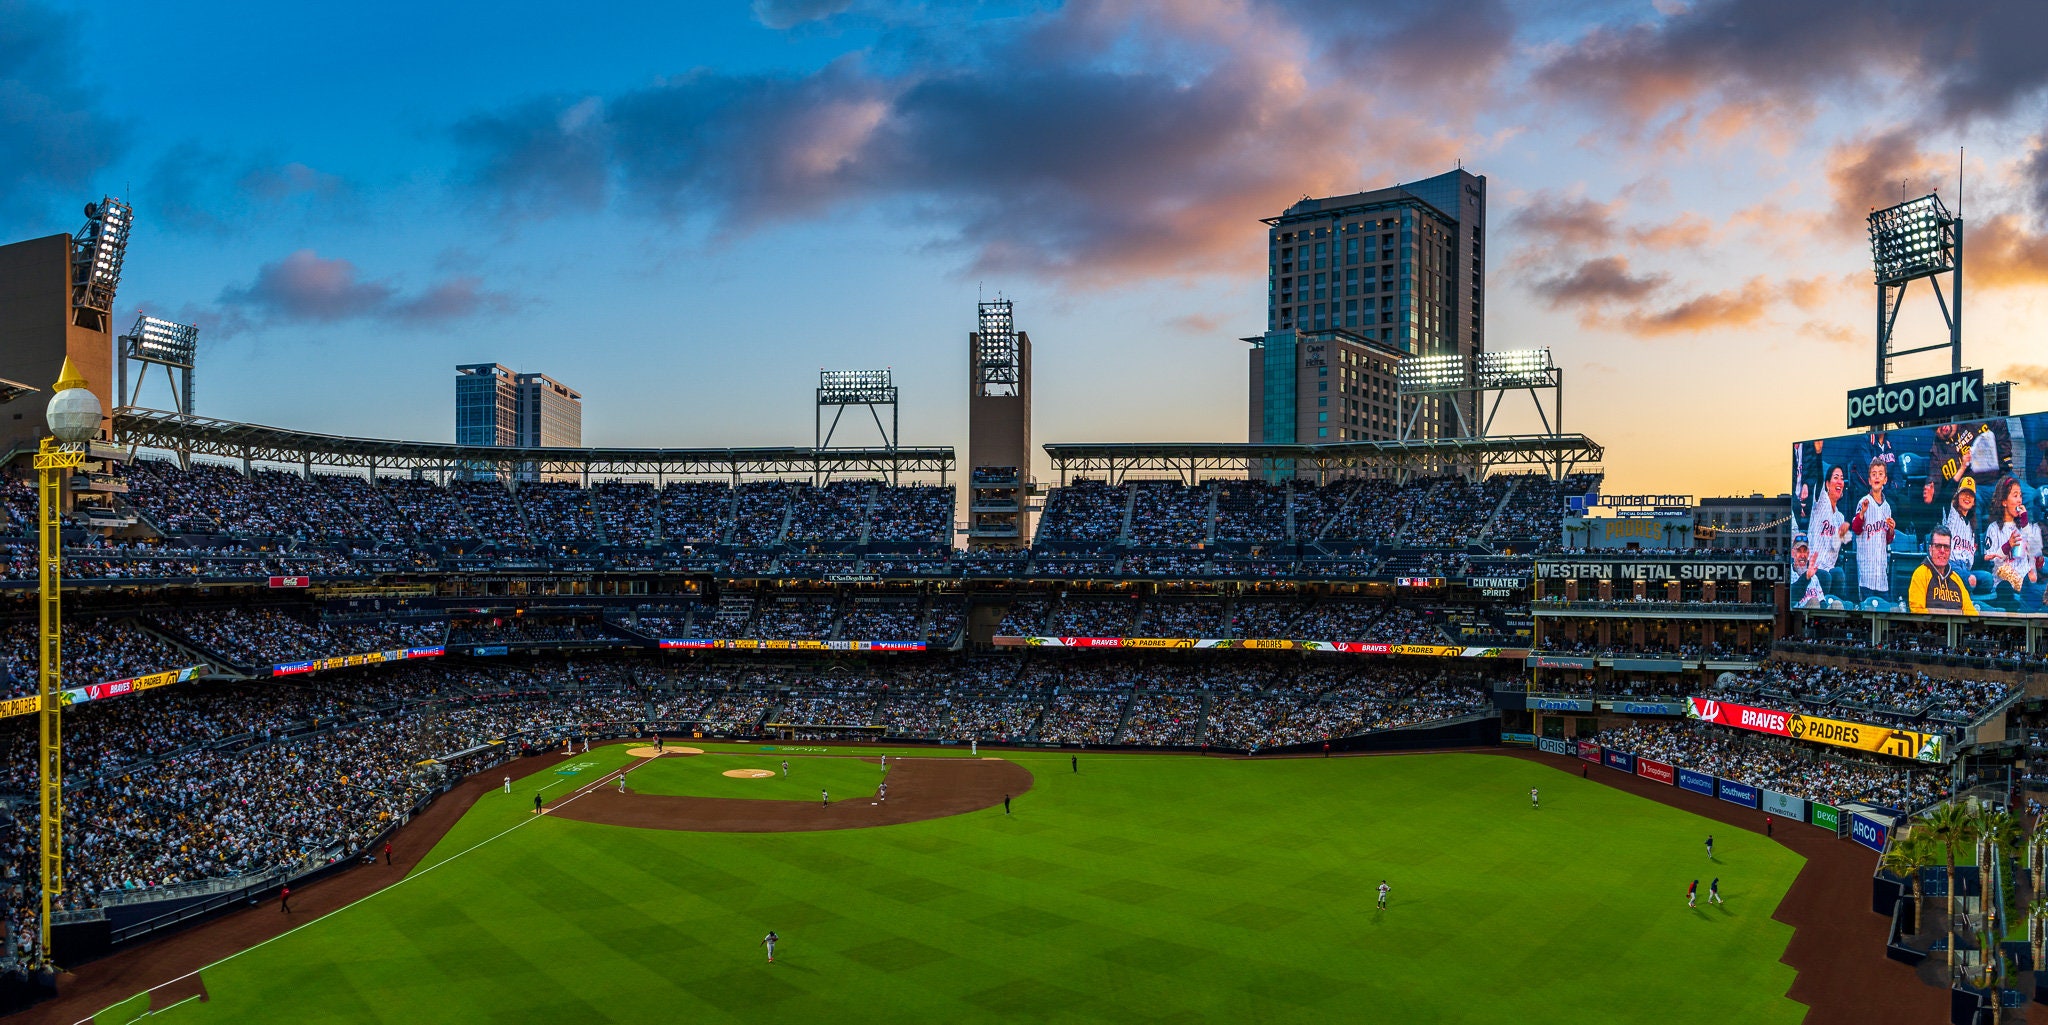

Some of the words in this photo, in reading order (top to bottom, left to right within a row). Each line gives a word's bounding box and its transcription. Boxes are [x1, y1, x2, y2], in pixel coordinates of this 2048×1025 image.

[1848, 387, 1915, 426] petco
[1918, 376, 1979, 417] park
[1601, 494, 1686, 509] QuidelOrtho
[1605, 519, 1662, 541] PADRES
[1537, 564, 1613, 579] WESTERN
[1620, 564, 1676, 579] METAL
[1680, 564, 1746, 580] SUPPLY
[1753, 565, 1784, 580] CO.
[1473, 578, 1519, 587] CUTWATER
[1482, 589, 1511, 597] SPIRITS
[1256, 639, 1282, 648] PADRES
[1361, 644, 1387, 652] BRAVES
[1392, 645, 1402, 653] VS
[1406, 646, 1433, 654] PADRES
[110, 682, 130, 694] BRAVES
[143, 676, 161, 686] PADRES
[10, 697, 37, 716] PADRES
[1538, 699, 1580, 710] Canel's
[1624, 703, 1668, 714] Canel's
[1741, 709, 1785, 731] BRAVES
[1790, 718, 1804, 732] VS
[1809, 721, 1860, 743] PADRES
[1540, 739, 1565, 753] ORIS
[1566, 745, 1577, 755] 342
[1647, 765, 1671, 778] Snapdragon
[1686, 775, 1712, 789] QuidelOrtho
[1721, 785, 1751, 801] Southwest
[1853, 820, 1876, 842] ARCO
